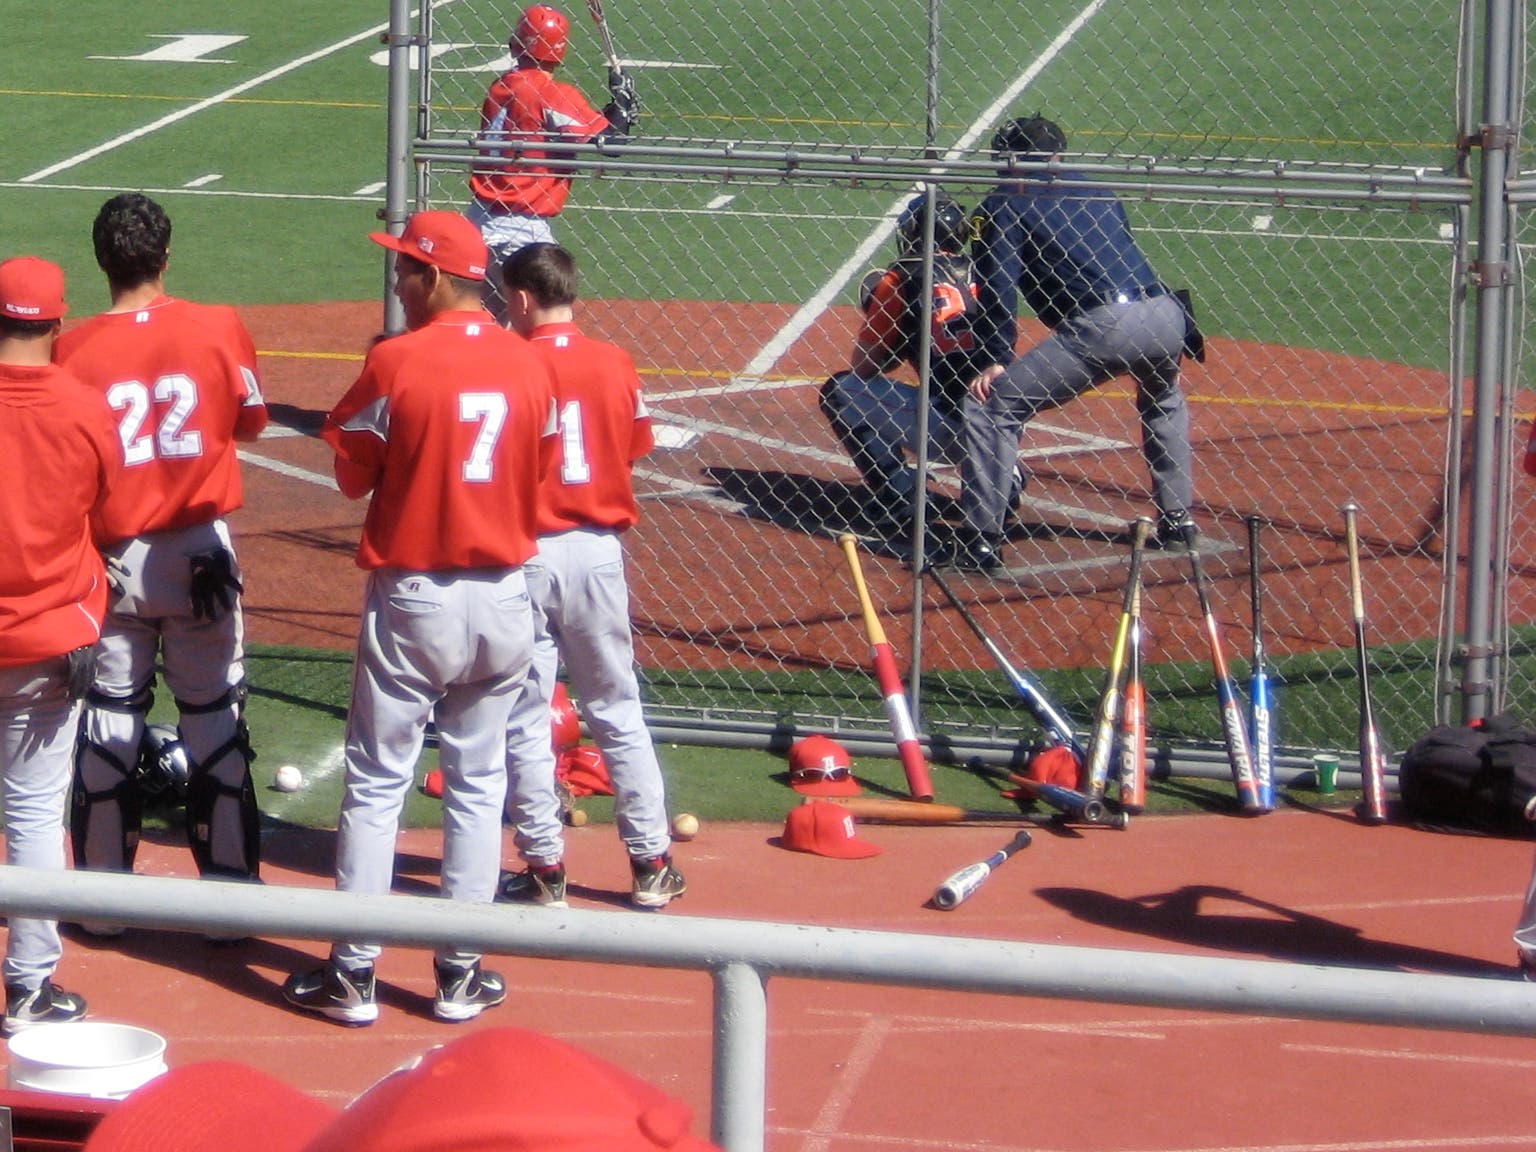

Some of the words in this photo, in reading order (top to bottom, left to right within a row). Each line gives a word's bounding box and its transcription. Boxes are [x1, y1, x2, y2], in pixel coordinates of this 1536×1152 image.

[107, 373, 203, 468] 22
[458, 391, 509, 484] 7
[559, 400, 592, 485] 1
[1254, 704, 1272, 787] STEALTH
